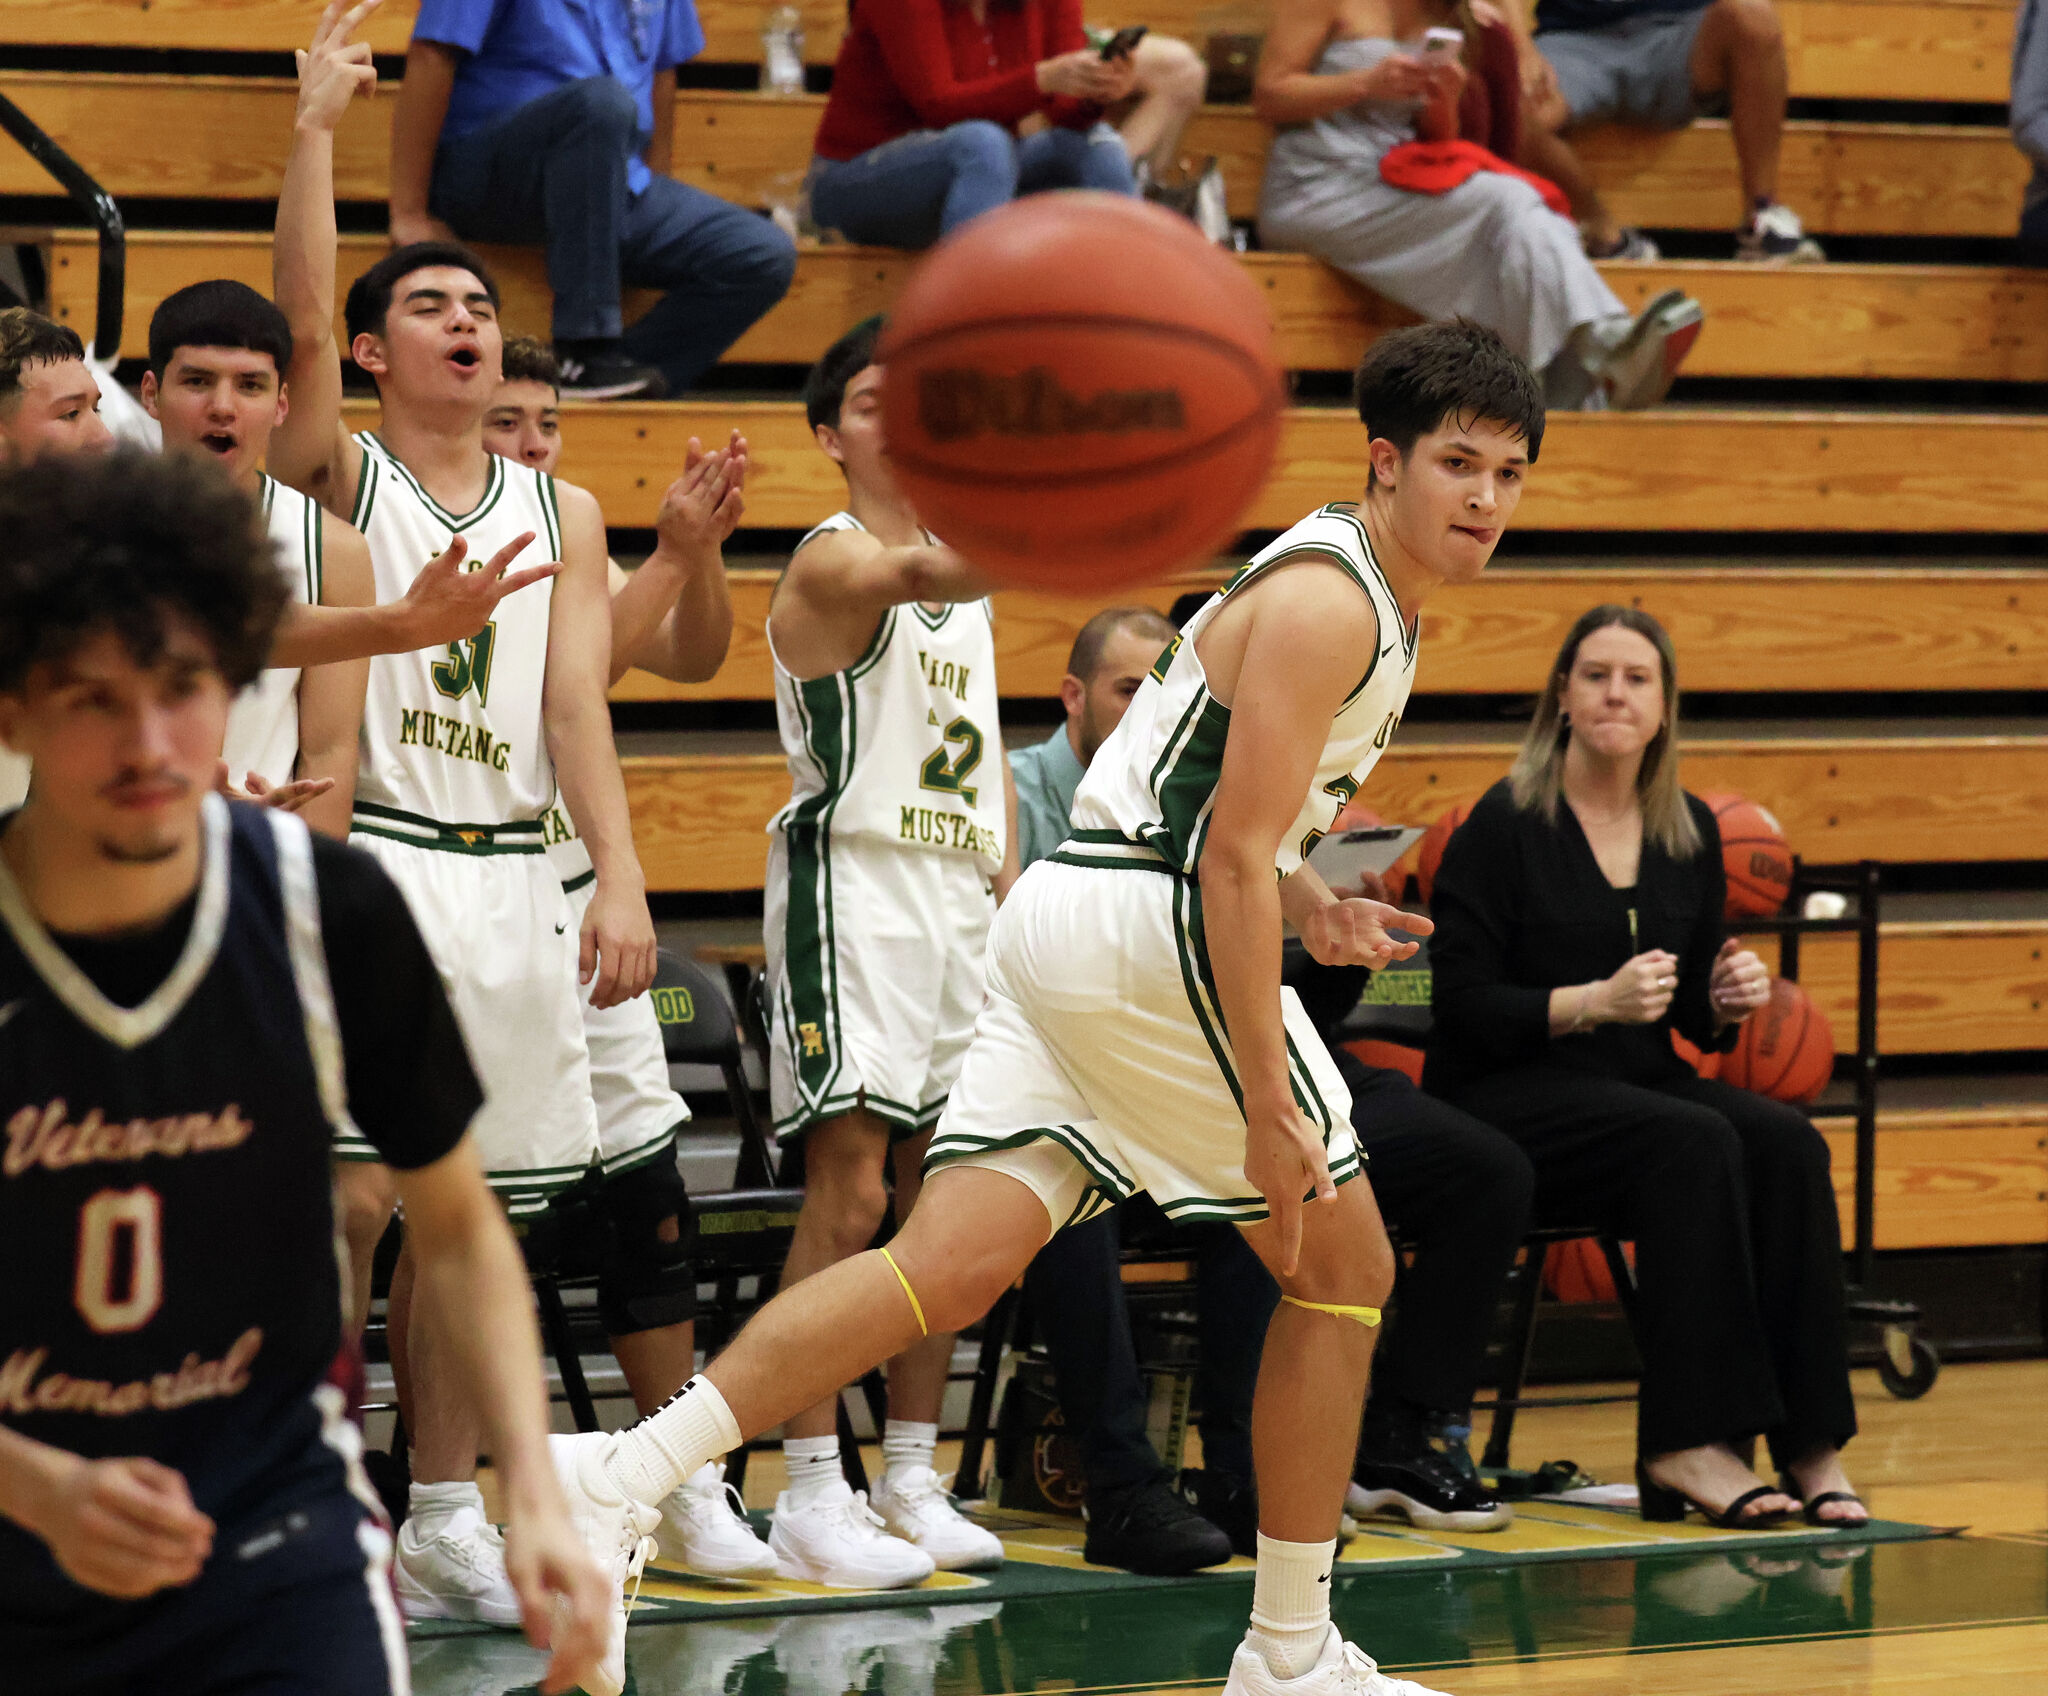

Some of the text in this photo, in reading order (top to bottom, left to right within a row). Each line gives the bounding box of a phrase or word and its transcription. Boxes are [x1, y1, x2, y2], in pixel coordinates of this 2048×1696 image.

[400, 708, 512, 773] MUTANG
[2, 1097, 254, 1177] Veterans
[75, 1184, 164, 1334] 0
[0, 1327, 264, 1416] Memorial
